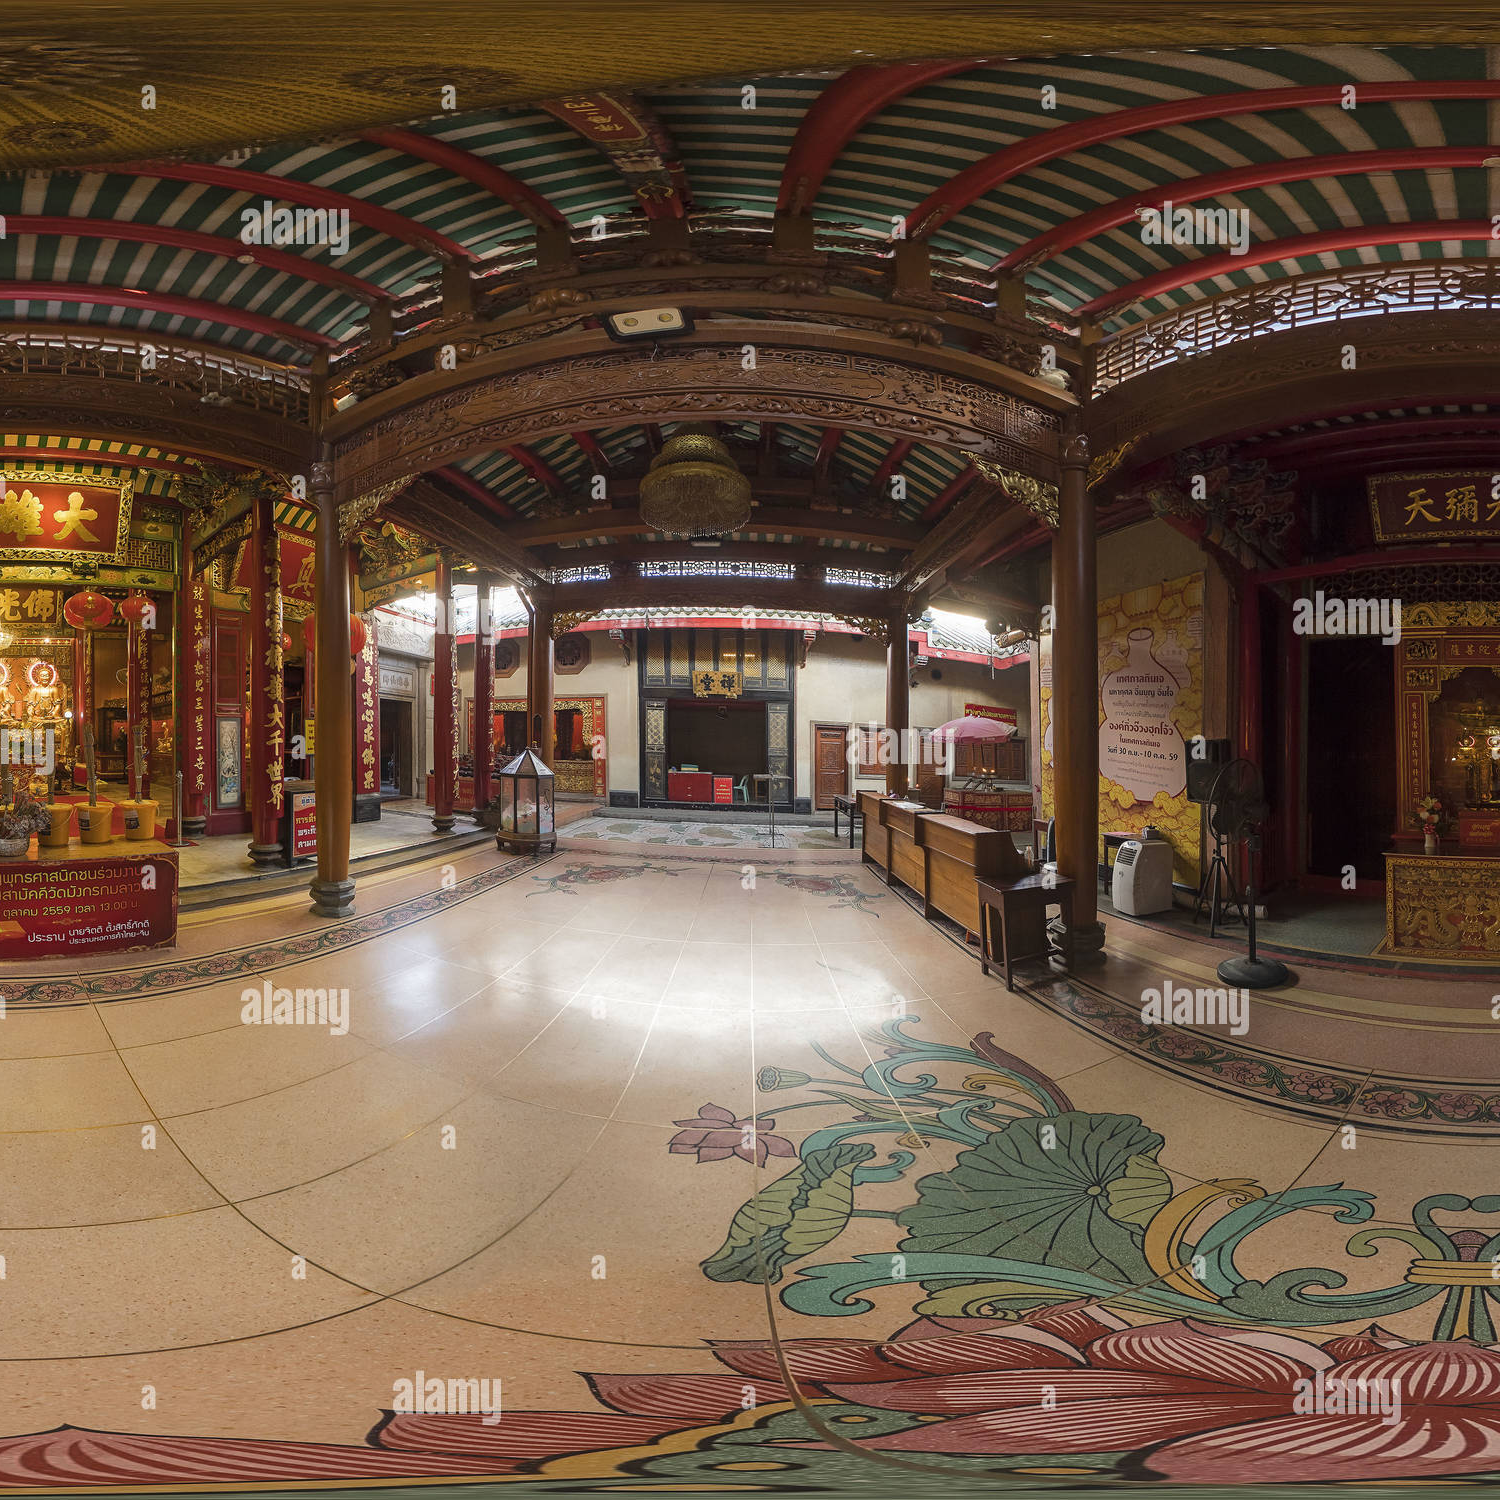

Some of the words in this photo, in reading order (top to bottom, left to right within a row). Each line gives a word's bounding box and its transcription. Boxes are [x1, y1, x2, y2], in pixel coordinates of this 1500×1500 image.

[1119, 747, 1127, 755] 30
[1169, 752, 1179, 761] 59
[3, 906, 38, 920] ตุลาคม
[42, 905, 71, 917] 2559
[27, 932, 66, 943] ประธาน
